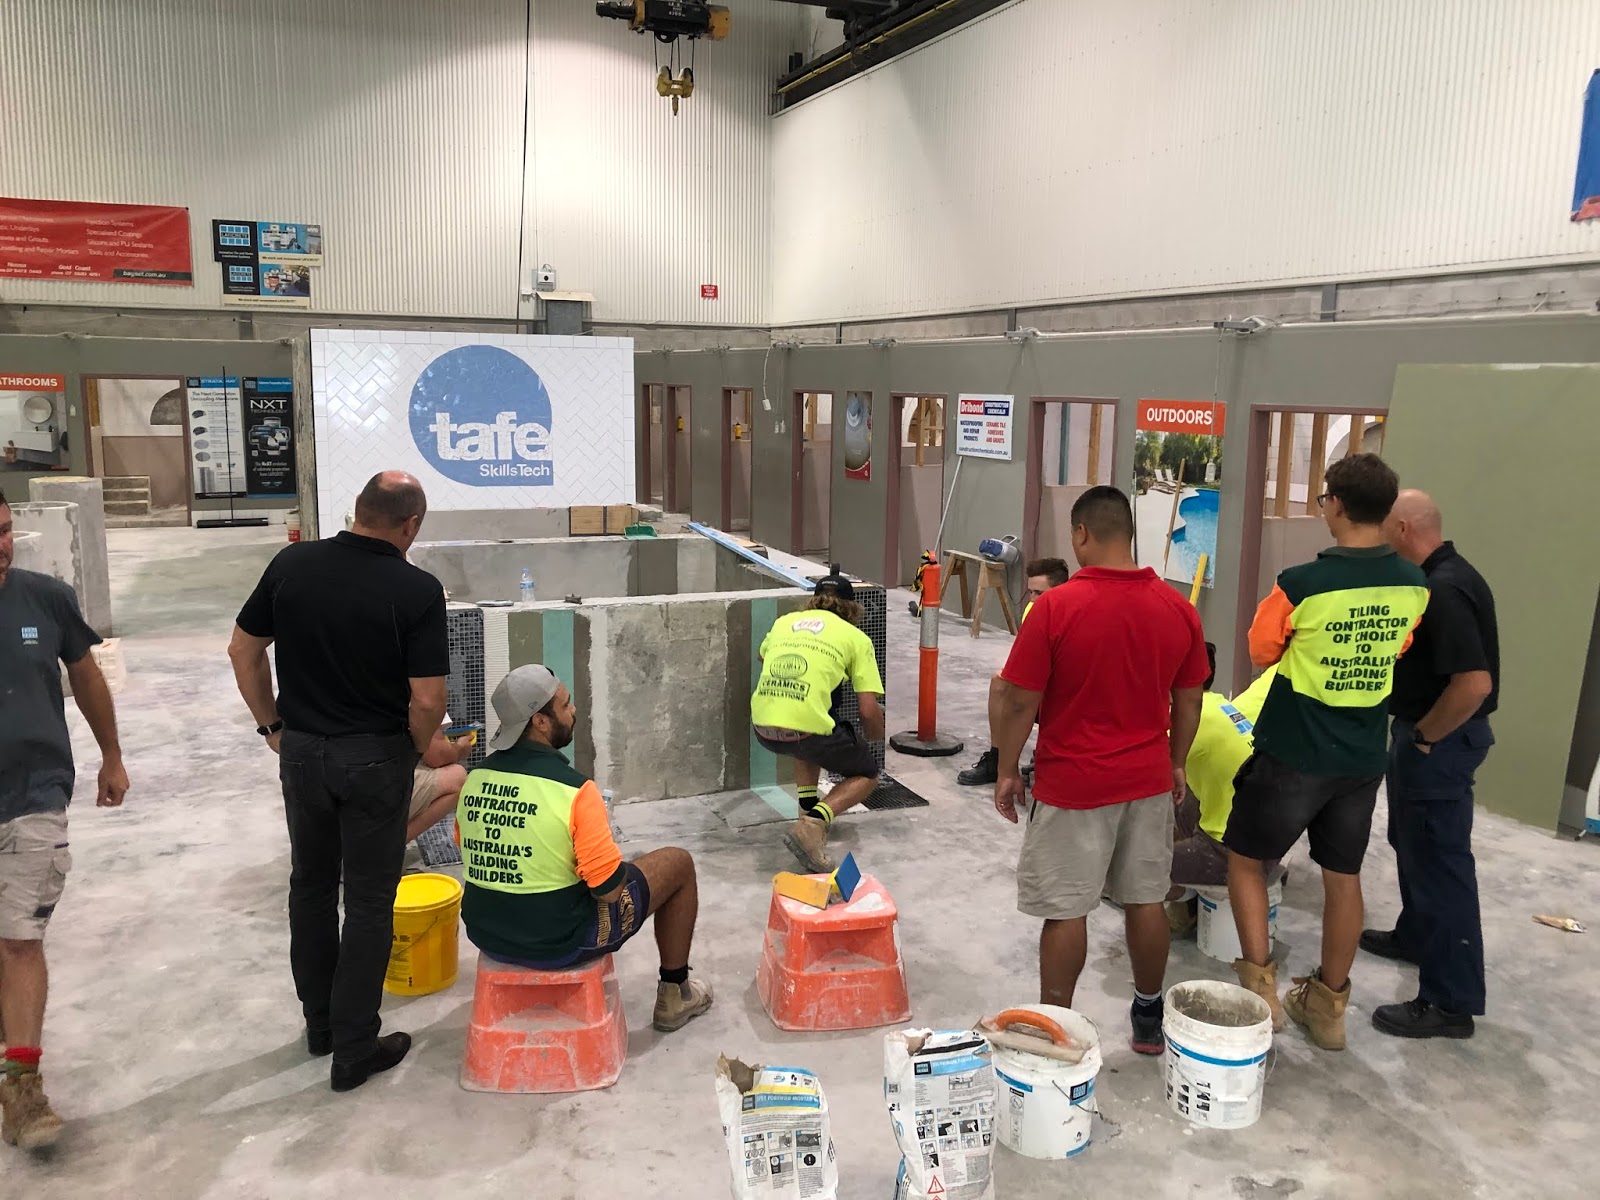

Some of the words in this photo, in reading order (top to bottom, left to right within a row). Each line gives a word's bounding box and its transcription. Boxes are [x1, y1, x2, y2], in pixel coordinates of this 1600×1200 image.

[250, 399, 287, 409] NXT
[961, 401, 984, 413] Dribond
[1146, 407, 1213, 425] OUTDOORS
[429, 411, 552, 461] tafe
[479, 463, 550, 478] SkillsTech
[1348, 605, 1390, 619] TILING
[1325, 617, 1409, 632] CONTRACTOR
[1332, 634, 1352, 644] OF
[1354, 630, 1398, 643] CHOICE
[1355, 643, 1372, 654] TO
[1331, 668, 1388, 681] LEADING
[481, 782, 520, 798] TILING
[463, 795, 538, 816] CONTRACTOR
[467, 810, 480, 822] OF
[482, 812, 526, 829] CHOICE
[484, 827, 501, 840] TO
[463, 838, 533, 858] AUSTRALIA'S
[470, 853, 518, 871] LEADING
[468, 866, 523, 885] BUILDERS
